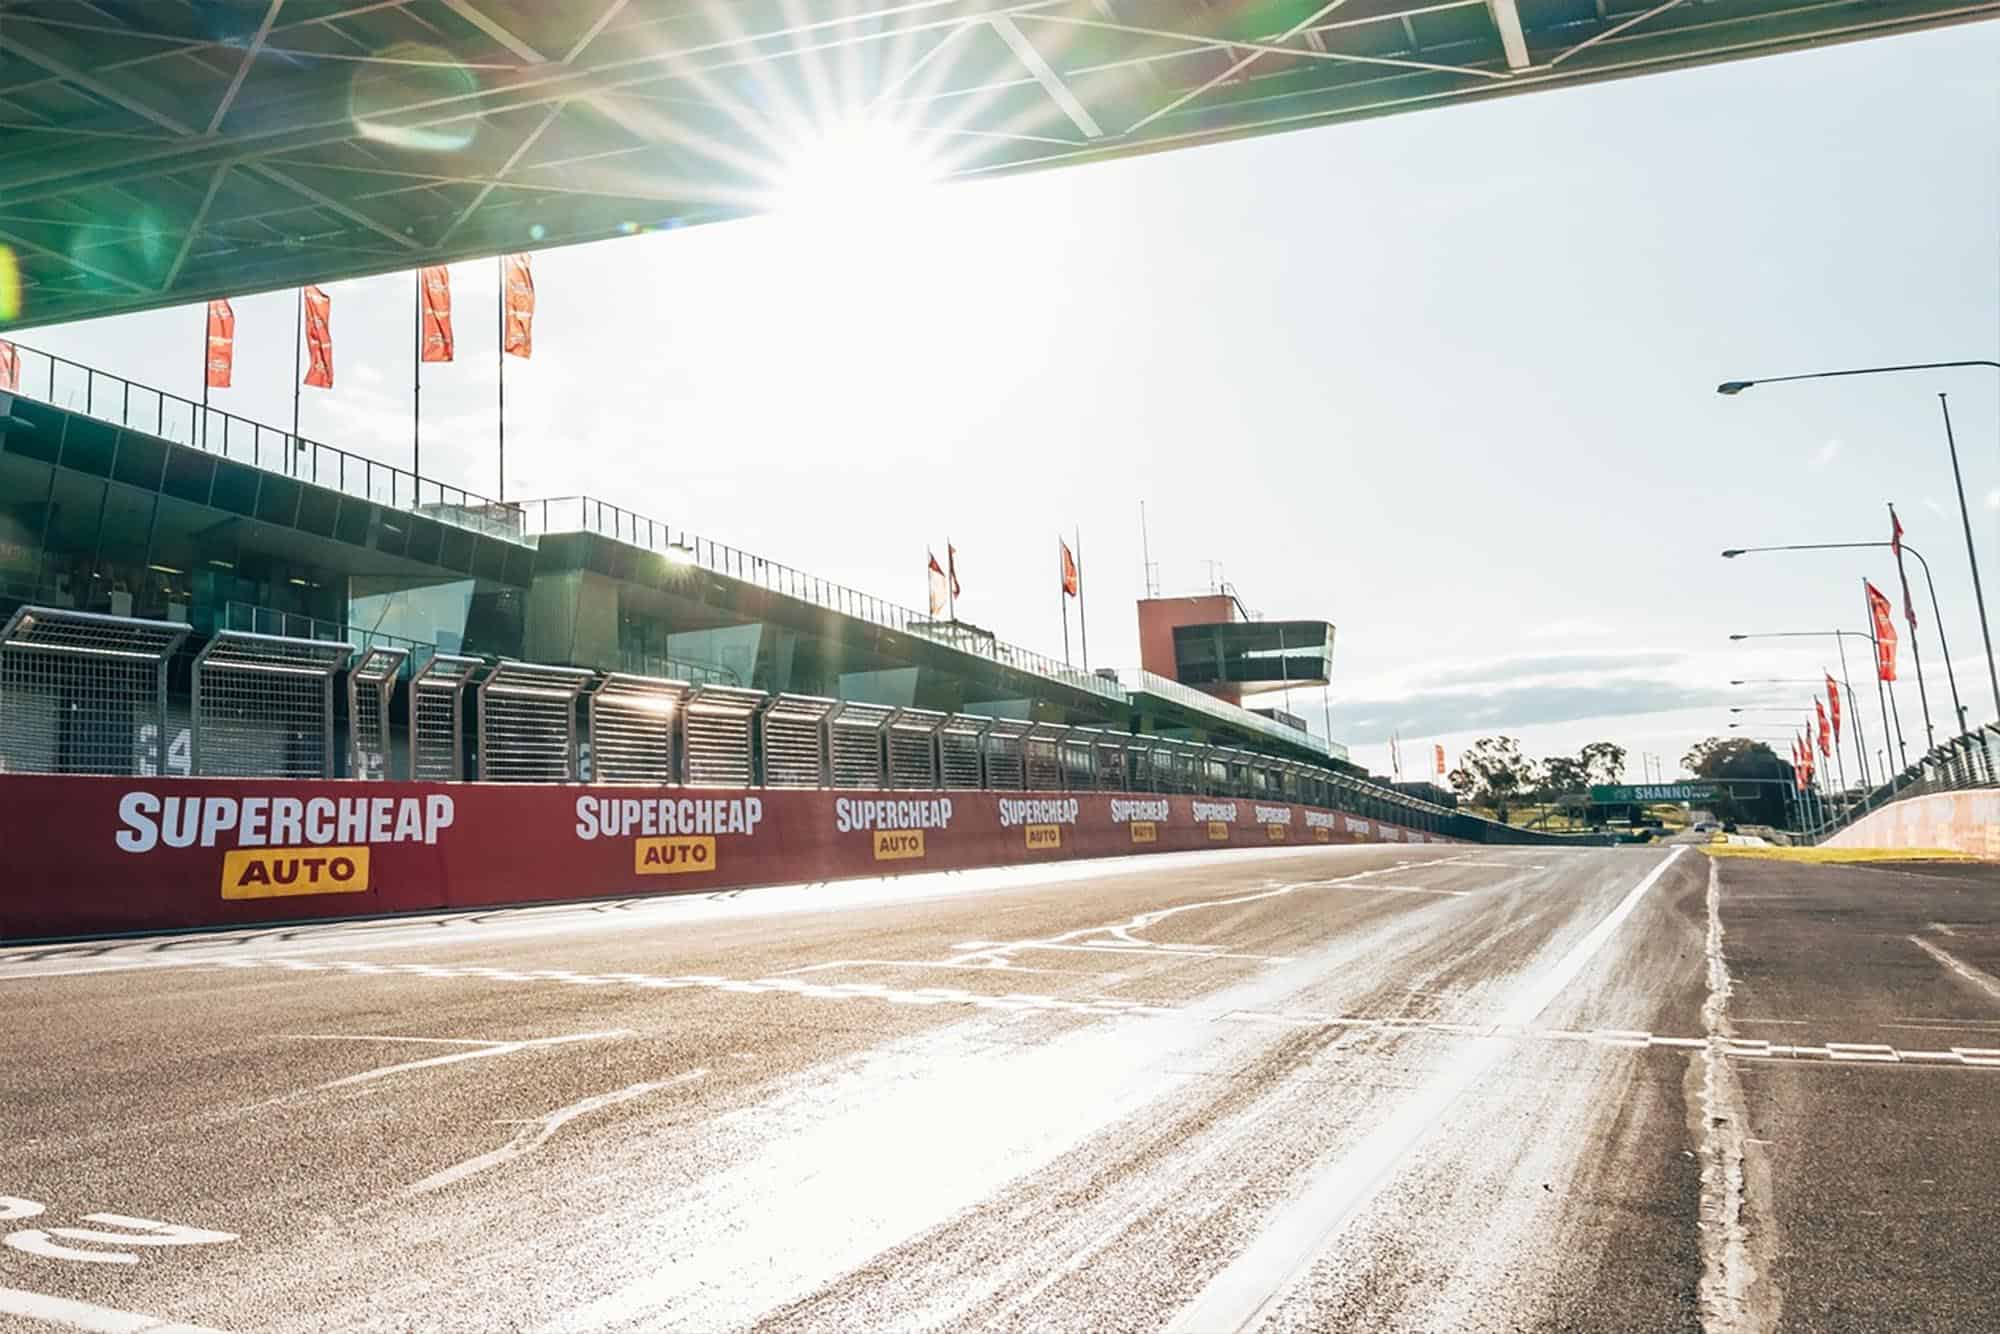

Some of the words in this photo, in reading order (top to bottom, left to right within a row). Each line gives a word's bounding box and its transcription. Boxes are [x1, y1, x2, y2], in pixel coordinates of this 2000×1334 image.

[115, 791, 453, 853] SUPERCHEAP
[575, 795, 762, 840] SUPERCHEAP
[836, 798, 952, 832] SUPERCHEAP
[999, 798, 1079, 827] SUPERCHEAP
[879, 836, 919, 853] AUTO
[1029, 829, 1057, 844] AUTO
[644, 844, 707, 865] AUTO
[237, 857, 356, 886] AUTO
